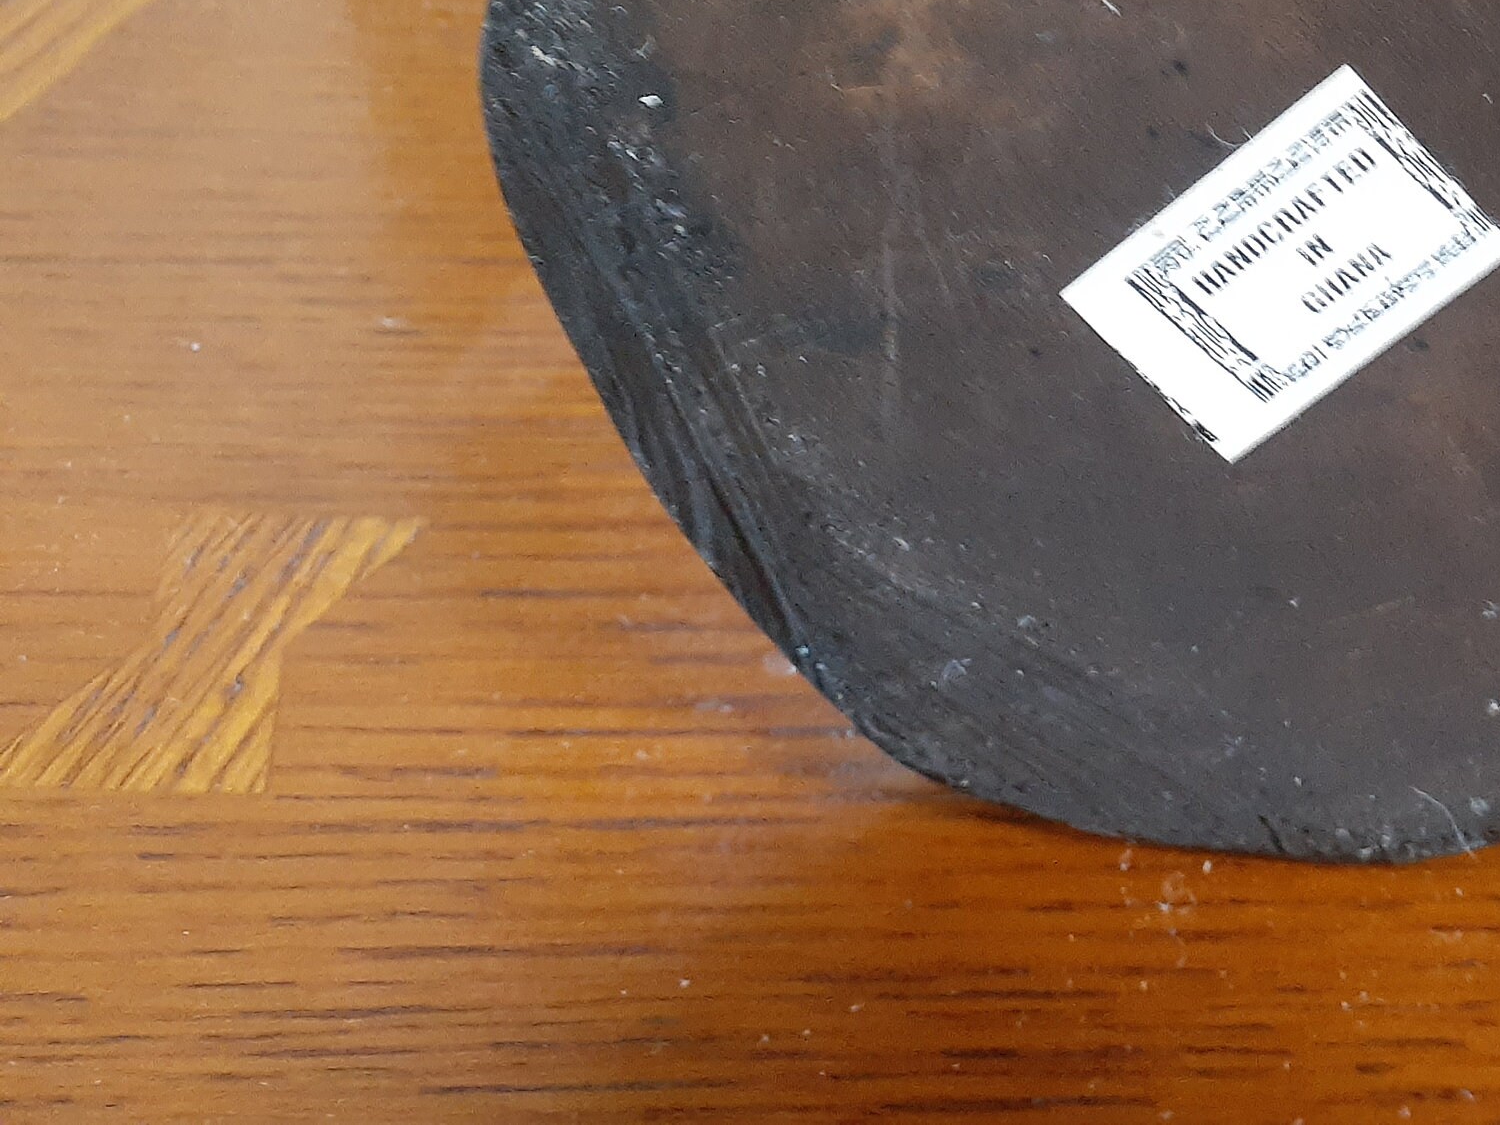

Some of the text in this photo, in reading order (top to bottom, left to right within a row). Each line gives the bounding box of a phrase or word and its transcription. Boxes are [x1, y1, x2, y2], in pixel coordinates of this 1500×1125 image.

[1191, 147, 1377, 296] HANDCRAFTED
[1296, 234, 1333, 267] IN
[1301, 243, 1393, 313] GHANA
